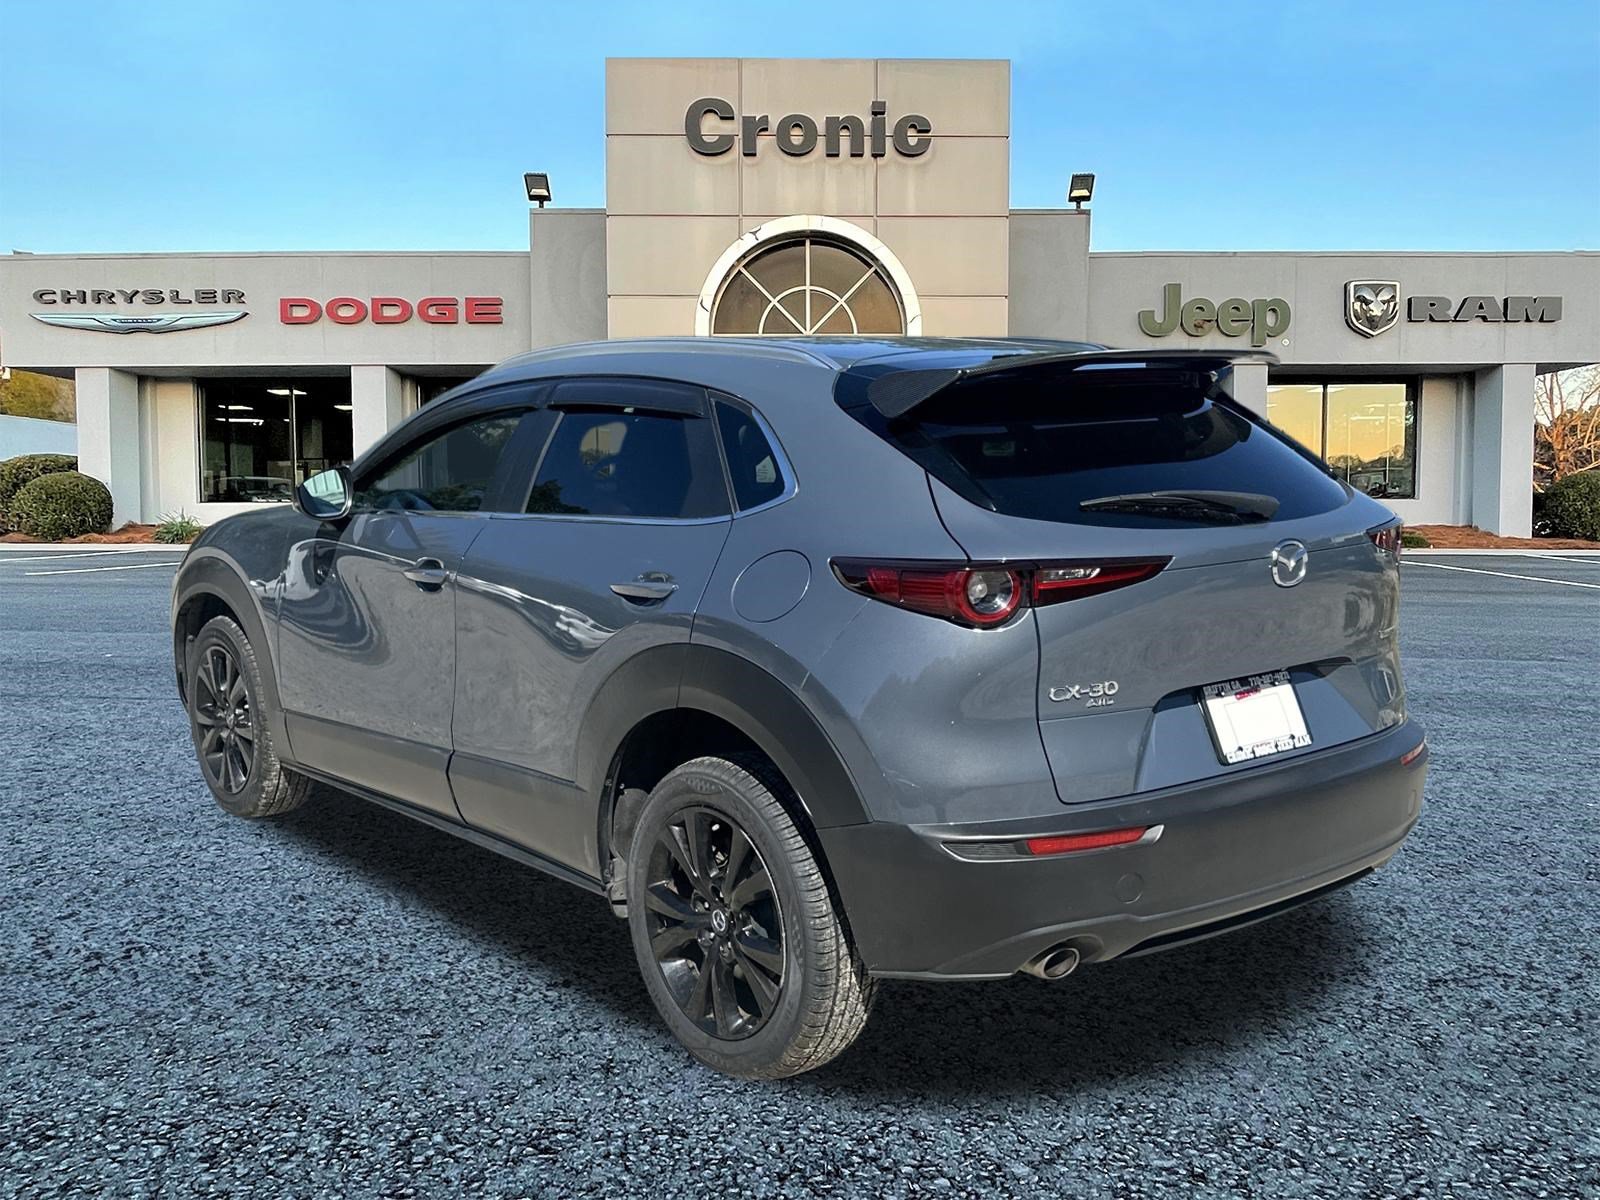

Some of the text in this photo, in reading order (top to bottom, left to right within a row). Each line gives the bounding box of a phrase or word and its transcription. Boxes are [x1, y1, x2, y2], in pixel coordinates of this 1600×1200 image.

[684, 97, 932, 157] Cronic
[32, 288, 246, 305] CHRYSLER
[1407, 296, 1562, 323] RAM
[279, 297, 503, 325] DODGE
[1138, 283, 1291, 348] Jeep
[1049, 680, 1119, 702] CX-30
